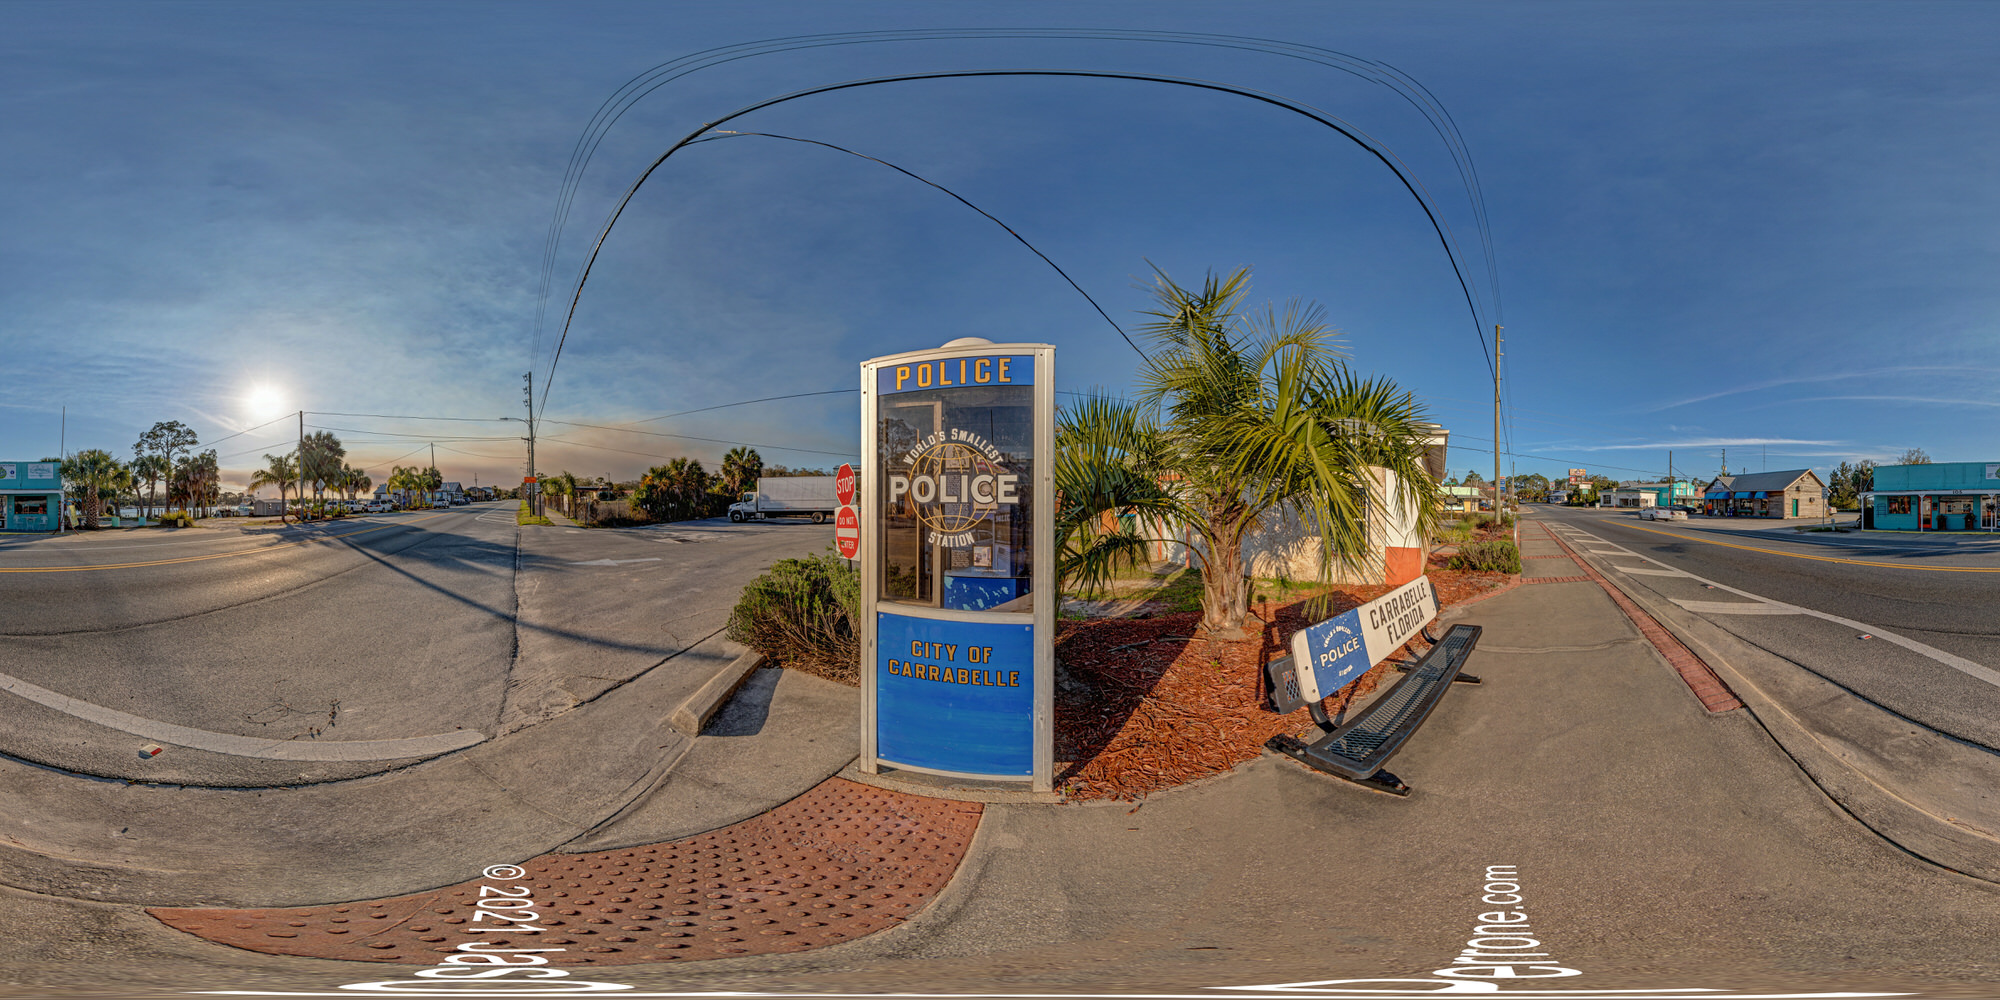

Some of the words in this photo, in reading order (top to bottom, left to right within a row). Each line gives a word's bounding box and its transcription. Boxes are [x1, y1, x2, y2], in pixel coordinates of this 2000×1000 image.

[896, 358, 1012, 391] POLICE
[903, 431, 946, 465] WORLD'S
[951, 428, 1004, 465] SMALLEST
[837, 476, 853, 494] STOP
[889, 474, 1019, 504] POLICE
[839, 517, 846, 526] DO
[846, 517, 855, 525] NOT
[928, 531, 975, 547] STATION
[1369, 582, 1427, 630] CARRABELLE
[1386, 605, 1425, 645] FLORIDA
[911, 640, 957, 661] CITY
[968, 646, 993, 664] OF
[1319, 637, 1360, 667] POLICE
[888, 659, 1020, 687] CARRABELLE
